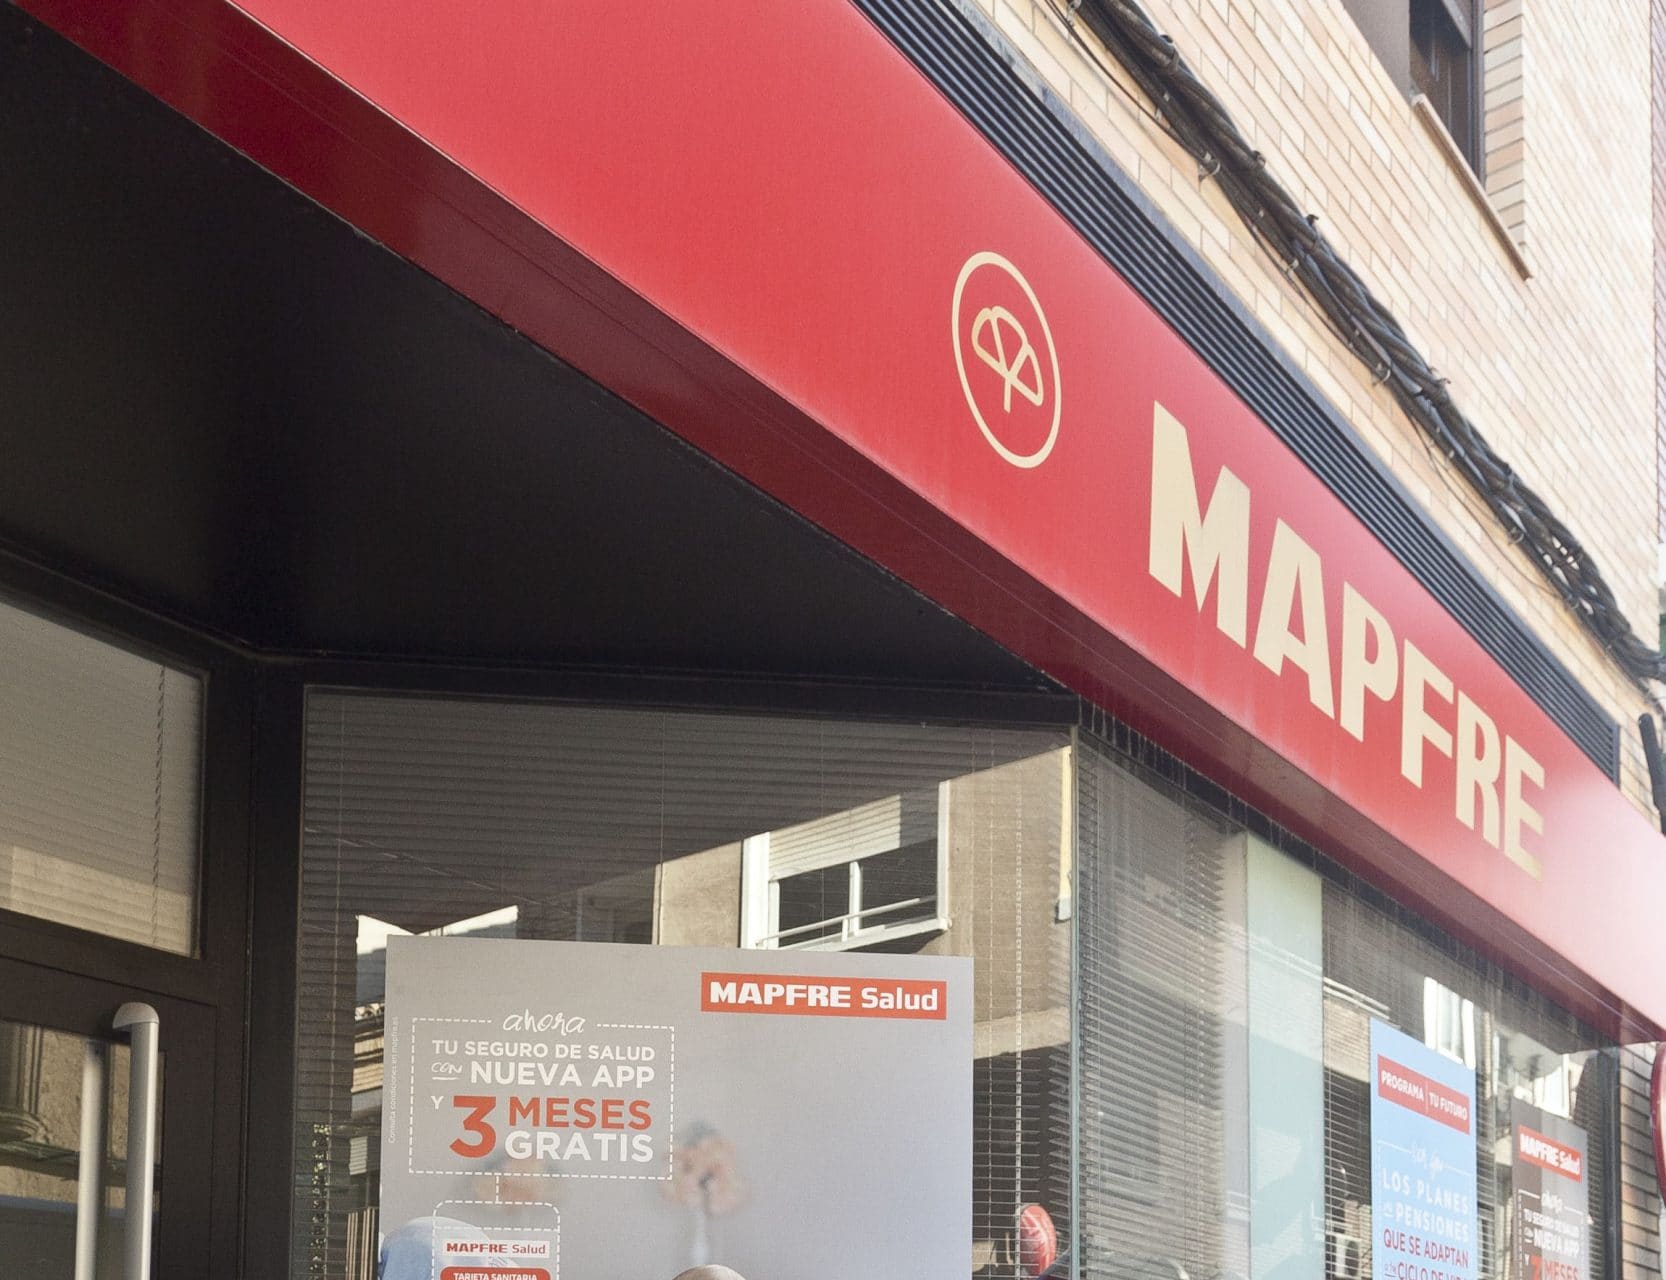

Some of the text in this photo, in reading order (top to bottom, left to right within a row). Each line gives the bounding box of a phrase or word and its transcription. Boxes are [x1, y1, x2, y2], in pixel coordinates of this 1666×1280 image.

[1149, 400, 1545, 881] MAPFRE
[710, 981, 938, 1011] MAPFRE Salud
[502, 1009, 586, 1036] ahora
[391, 1054, 397, 1064] en
[432, 1040, 655, 1061] TU SEGURO DE SALUD
[471, 1061, 583, 1087] NUEVA
[592, 1065, 655, 1089] APP
[1381, 1070, 1468, 1120] PROGRAMA TU FUTURO
[388, 1111, 397, 1143] Consulta
[431, 1095, 652, 1158] Y 3 MESES
[504, 1131, 654, 1162] GRATIS
[1520, 1133, 1560, 1167] MAPFRE
[1383, 1168, 1469, 1215] LOS PLANES
[1396, 1201, 1469, 1242] PENSIONES
[446, 1242, 546, 1254] MAPFRE Salud
[1384, 1228, 1468, 1268] QUE SE ADAPTAN
